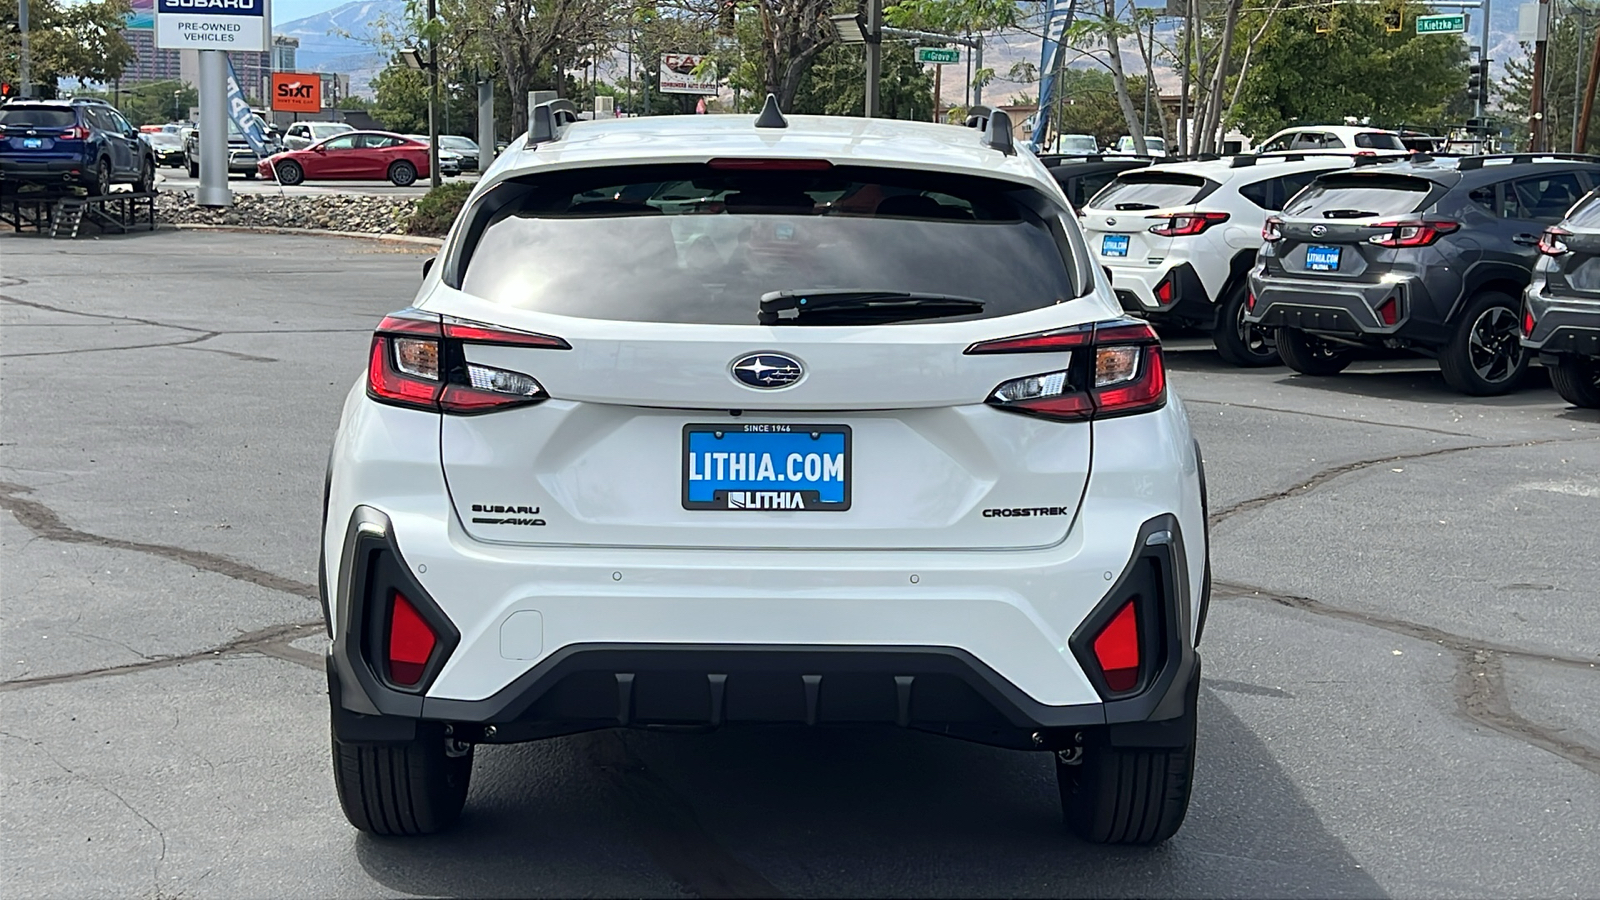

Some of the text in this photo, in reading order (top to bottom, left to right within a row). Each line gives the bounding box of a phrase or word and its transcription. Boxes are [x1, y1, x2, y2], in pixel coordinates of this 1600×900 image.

[165, 0, 254, 9] SUBARU
[178, 22, 241, 32] PRE-OWNED
[1424, 19, 1452, 30] Kietzke
[184, 33, 235, 42] VEHICLES
[931, 52, 950, 61] Grove
[1306, 253, 1339, 264] LITHIA.COM
[744, 424, 791, 432] SINCE 1946
[689, 452, 844, 482] LITHIA.COM
[745, 491, 805, 509] LITHIA
[472, 504, 540, 514] SUBARU
[982, 506, 1067, 517] CROSSTREK
[500, 518, 547, 526] AWD
